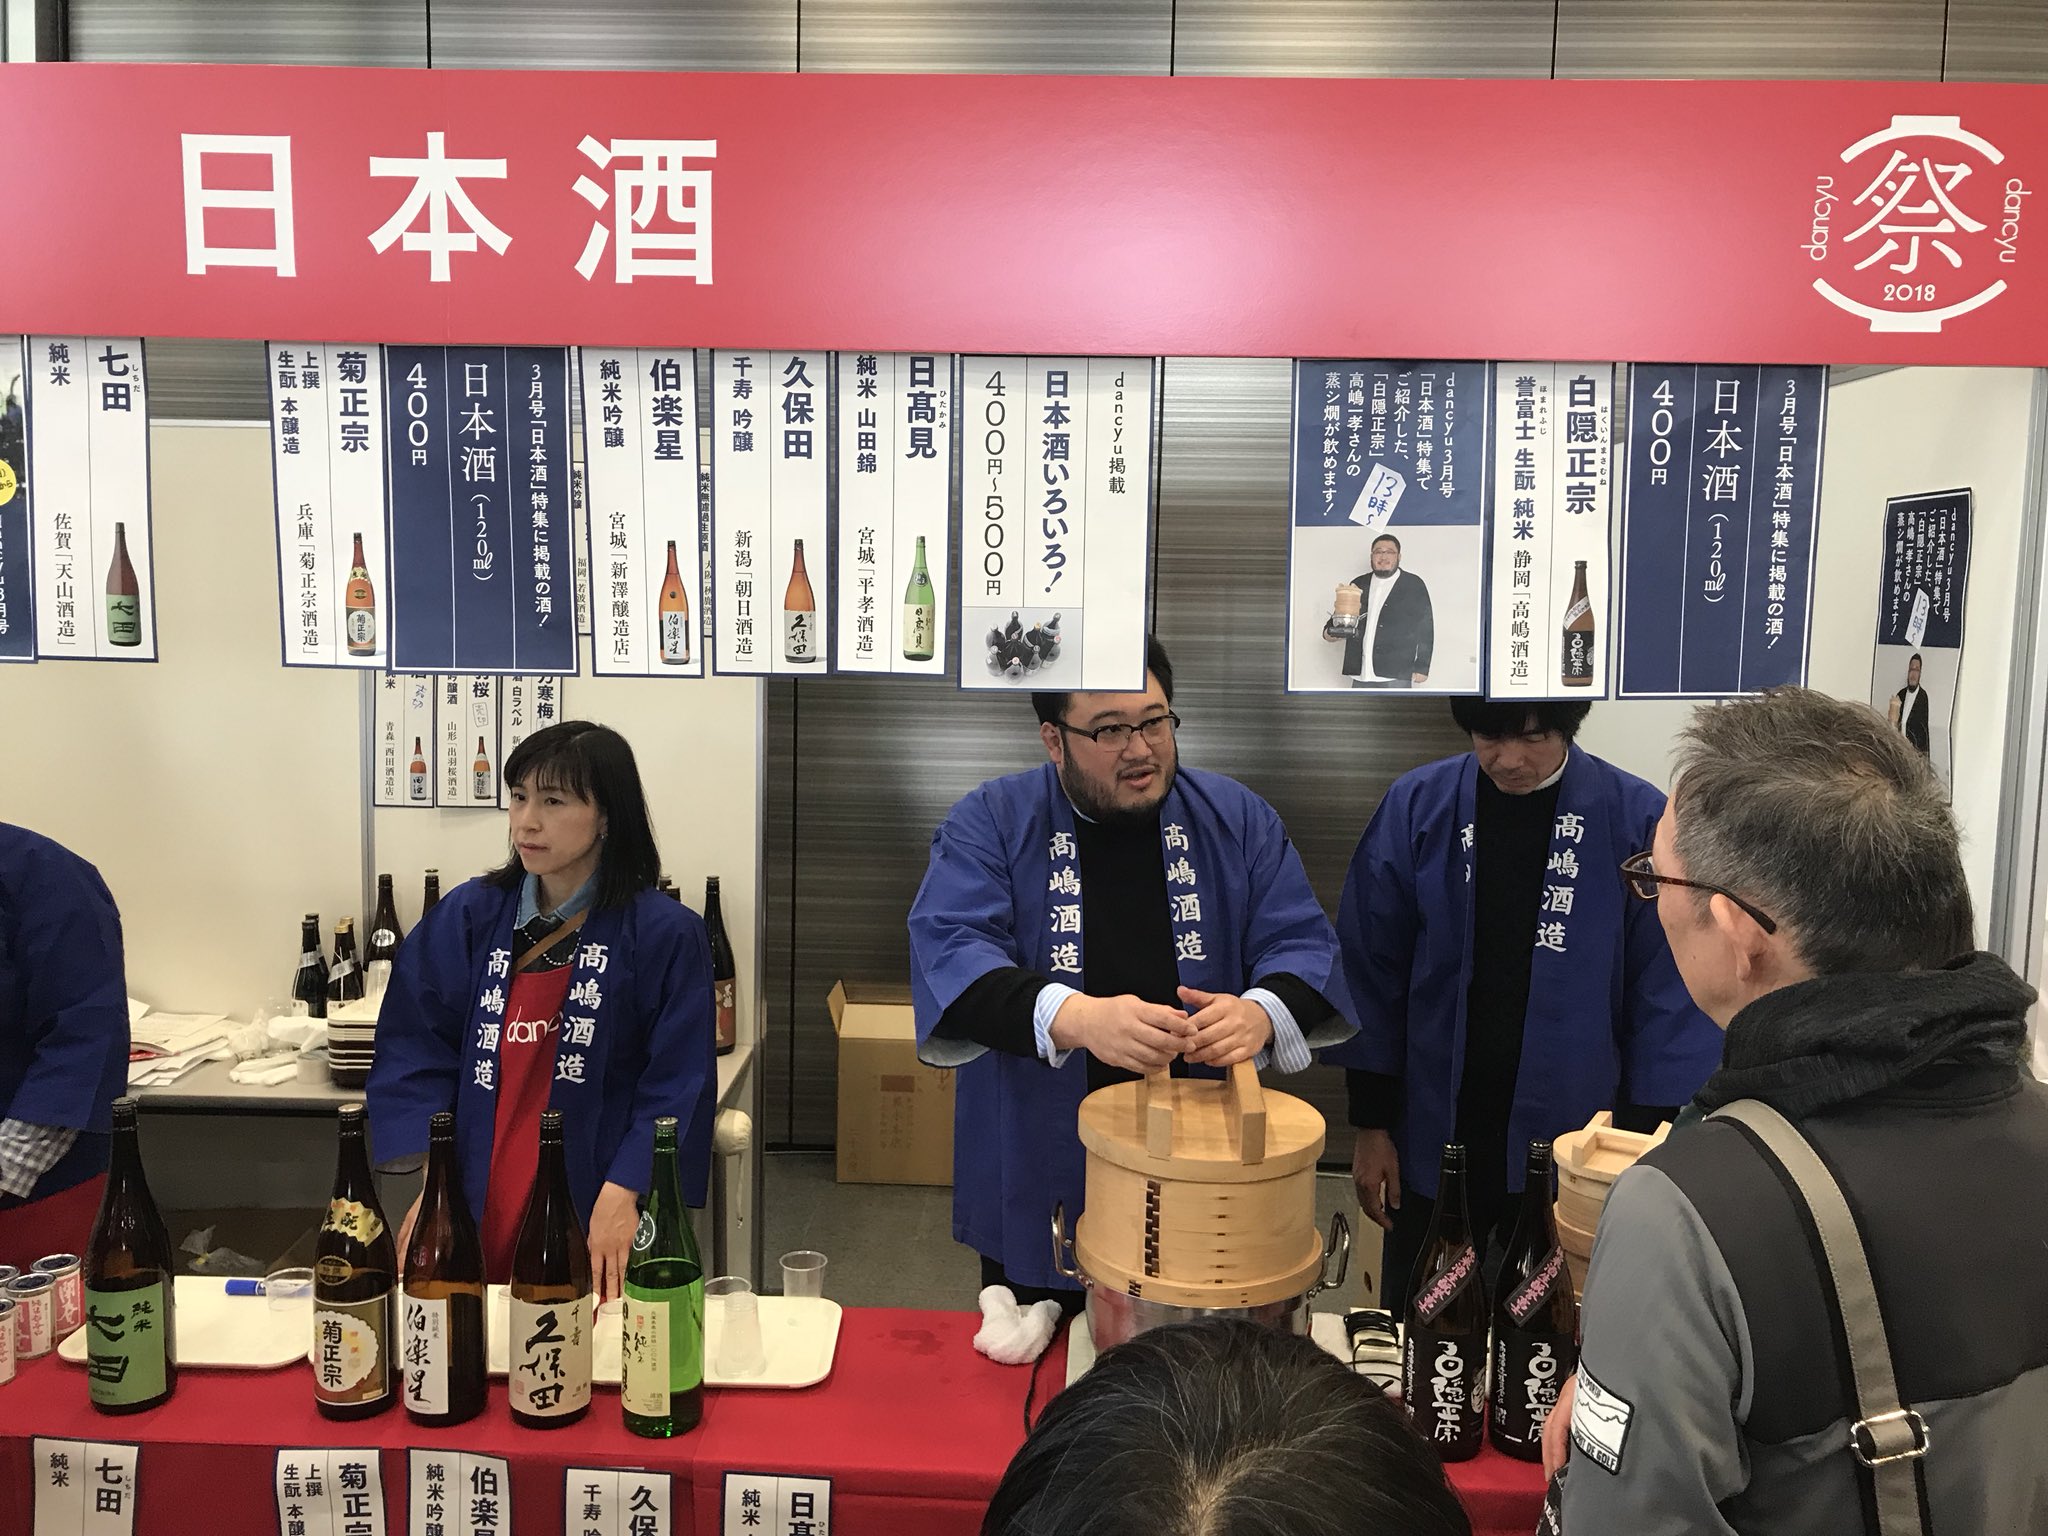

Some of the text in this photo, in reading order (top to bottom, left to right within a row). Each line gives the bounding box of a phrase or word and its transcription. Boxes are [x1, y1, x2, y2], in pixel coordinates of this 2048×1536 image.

[181, 132, 717, 285] 日本酒
[1801, 176, 1839, 261] dancyu
[1843, 149, 1988, 274] 祭
[1994, 178, 2032, 263] dancyu
[1883, 284, 1935, 301] 2018
[48, 344, 71, 386] 純米
[98, 346, 132, 411] 七田
[132, 364, 141, 392] しちだ
[278, 351, 301, 454] 生酛 本醸造
[301, 351, 320, 388] 上撰
[337, 351, 370, 453] 菊正宗
[600, 360, 624, 448] 純米吟醸
[650, 359, 684, 461] 伯楽星
[732, 357, 753, 452] 千寿 吟醸
[782, 357, 814, 459] 久保田
[939, 390, 948, 429] ひたかみ
[1539, 385, 1548, 435] ほまれふじ
[406, 363, 429, 465] 400円
[856, 355, 878, 474] 純米 山田錦
[1109, 372, 1126, 494] dancyu掲載
[1346, 372, 1364, 476] 高嶋一孝さんの
[1369, 373, 1388, 457] 「白隠正宗」
[1394, 372, 1412, 461] ご紹介した、
[1416, 372, 1435, 491] 「日本酒」特集で
[1439, 372, 1455, 498] dancyu3月号
[1512, 376, 1536, 540] 誉富士 生酛 純米
[1565, 375, 1598, 514] 白隠正宗
[1649, 380, 1674, 485] 400円
[1042, 371, 1071, 593] 日本酒いろいろ！
[54, 513, 76, 646] 佐賀「天山酒造」
[111, 601, 136, 633] 七田
[297, 504, 319, 655] 兵庫「菊正宗酒造」
[609, 512, 630, 664] 宮城「新澤醸造店」
[734, 530, 753, 663] 新潟「朝日酒造」
[856, 527, 876, 661] 宮城「平孝酒造」
[1510, 549, 1532, 687] 静岡「高嶋酒造」
[357, 614, 365, 642] 菊正宗
[668, 614, 680, 654] 伯楽星
[789, 614, 807, 654] 久保田
[511, 687, 523, 726] 白ラベル
[323, 1320, 343, 1387] 菊正宗
[405, 1304, 431, 1404] 伯楽星
[519, 1310, 566, 1410] 久保田
[50, 1452, 69, 1487] 純米
[95, 1458, 123, 1515] 七田
[284, 1464, 301, 1498] 生酛
[305, 1464, 323, 1497] 上撰
[583, 1484, 601, 1521] 千寿
[1586, 1444, 1595, 1456] DE
[1596, 1452, 1616, 1470] GOLF
[742, 1489, 760, 1526] 純米
